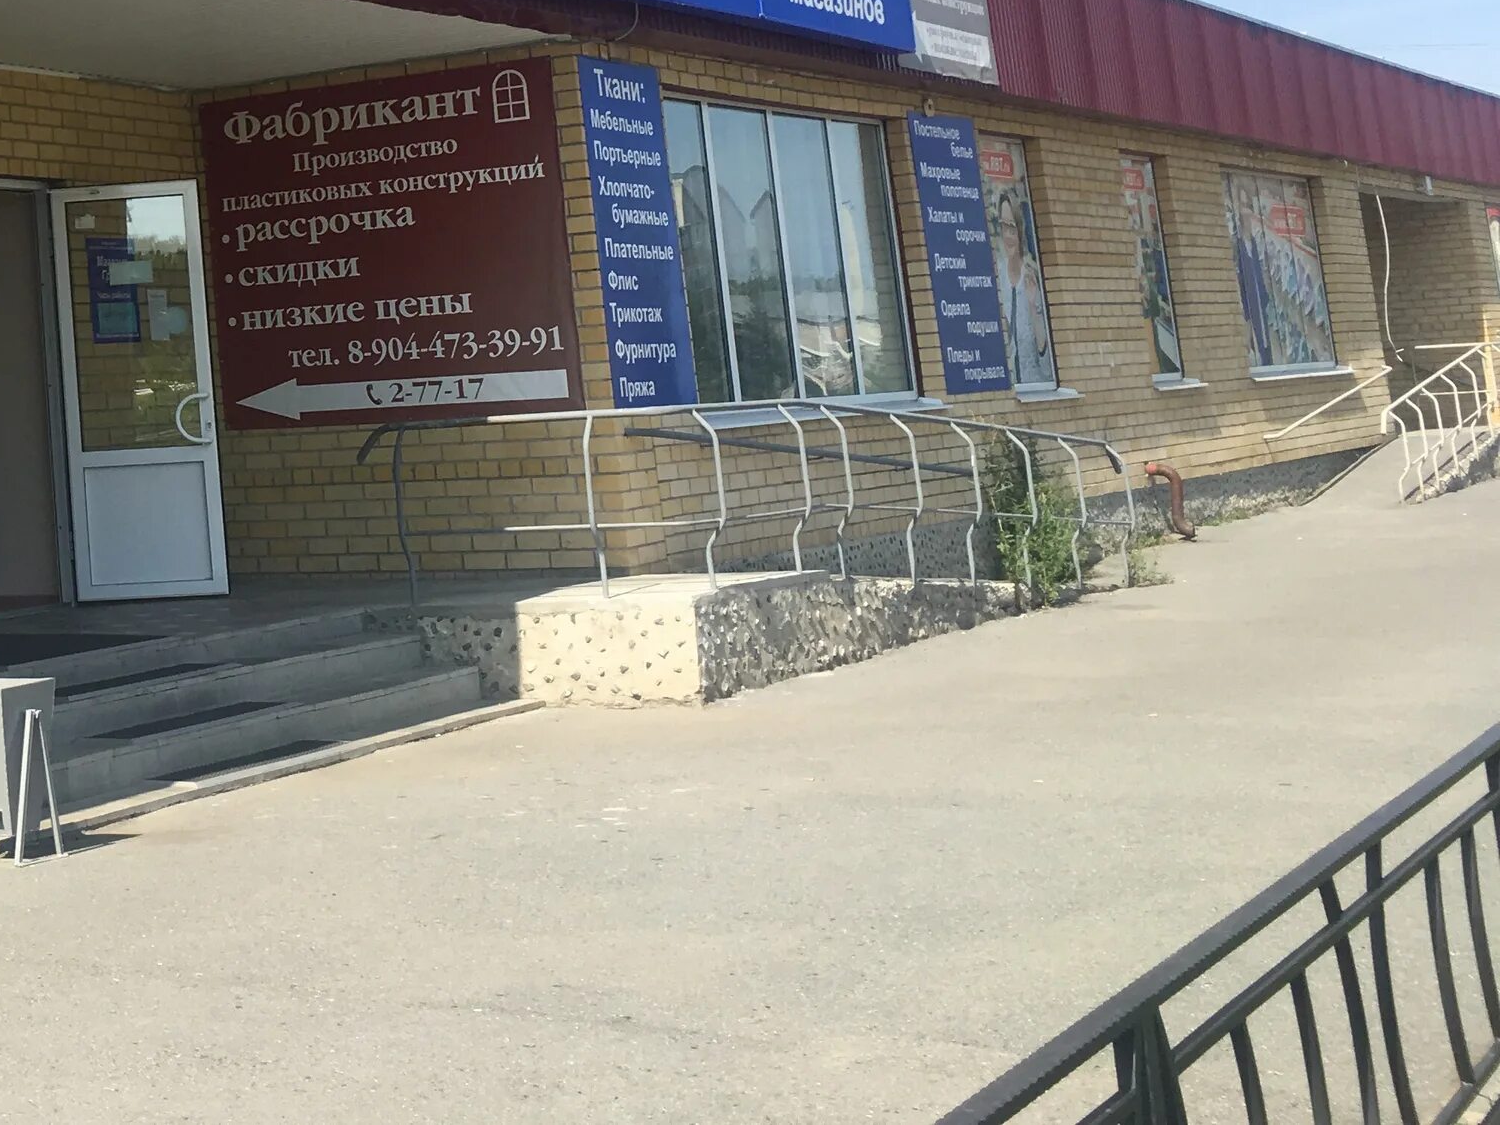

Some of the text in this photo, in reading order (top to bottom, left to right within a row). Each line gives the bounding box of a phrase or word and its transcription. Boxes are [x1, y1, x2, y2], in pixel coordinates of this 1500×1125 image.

[593, 68, 646, 104] Ткани:
[222, 85, 481, 146] Фабрикант
[590, 107, 654, 136] Мебельные
[913, 120, 960, 140] Постельное
[292, 137, 459, 177] Производство
[593, 139, 662, 169] Портьерные
[221, 154, 546, 213] пластиковых конструкций
[920, 161, 961, 182] Махровые
[598, 174, 655, 200] Хлопчато-
[941, 185, 979, 201] полотенца
[611, 202, 669, 228] бумажные
[927, 206, 957, 223] Халаты
[235, 204, 416, 253] рассрочка
[956, 229, 987, 245] сорочки
[604, 236, 674, 261] Плательные
[237, 255, 361, 288] скидки
[934, 253, 967, 271] Детский
[608, 270, 639, 291] Флис
[958, 276, 993, 291] трикотаж
[241, 291, 473, 332] низкие цены
[609, 301, 663, 327] Трикотаж
[940, 300, 971, 318] Одеяла
[967, 321, 999, 337] подушки
[288, 325, 565, 368] тел. 8-904-473-39-91
[615, 338, 677, 364] Фурнитура
[947, 347, 974, 364] Пледы
[964, 366, 1005, 383] покрывала
[388, 377, 485, 404] 2-77-17
[619, 376, 656, 406] Пряжа
